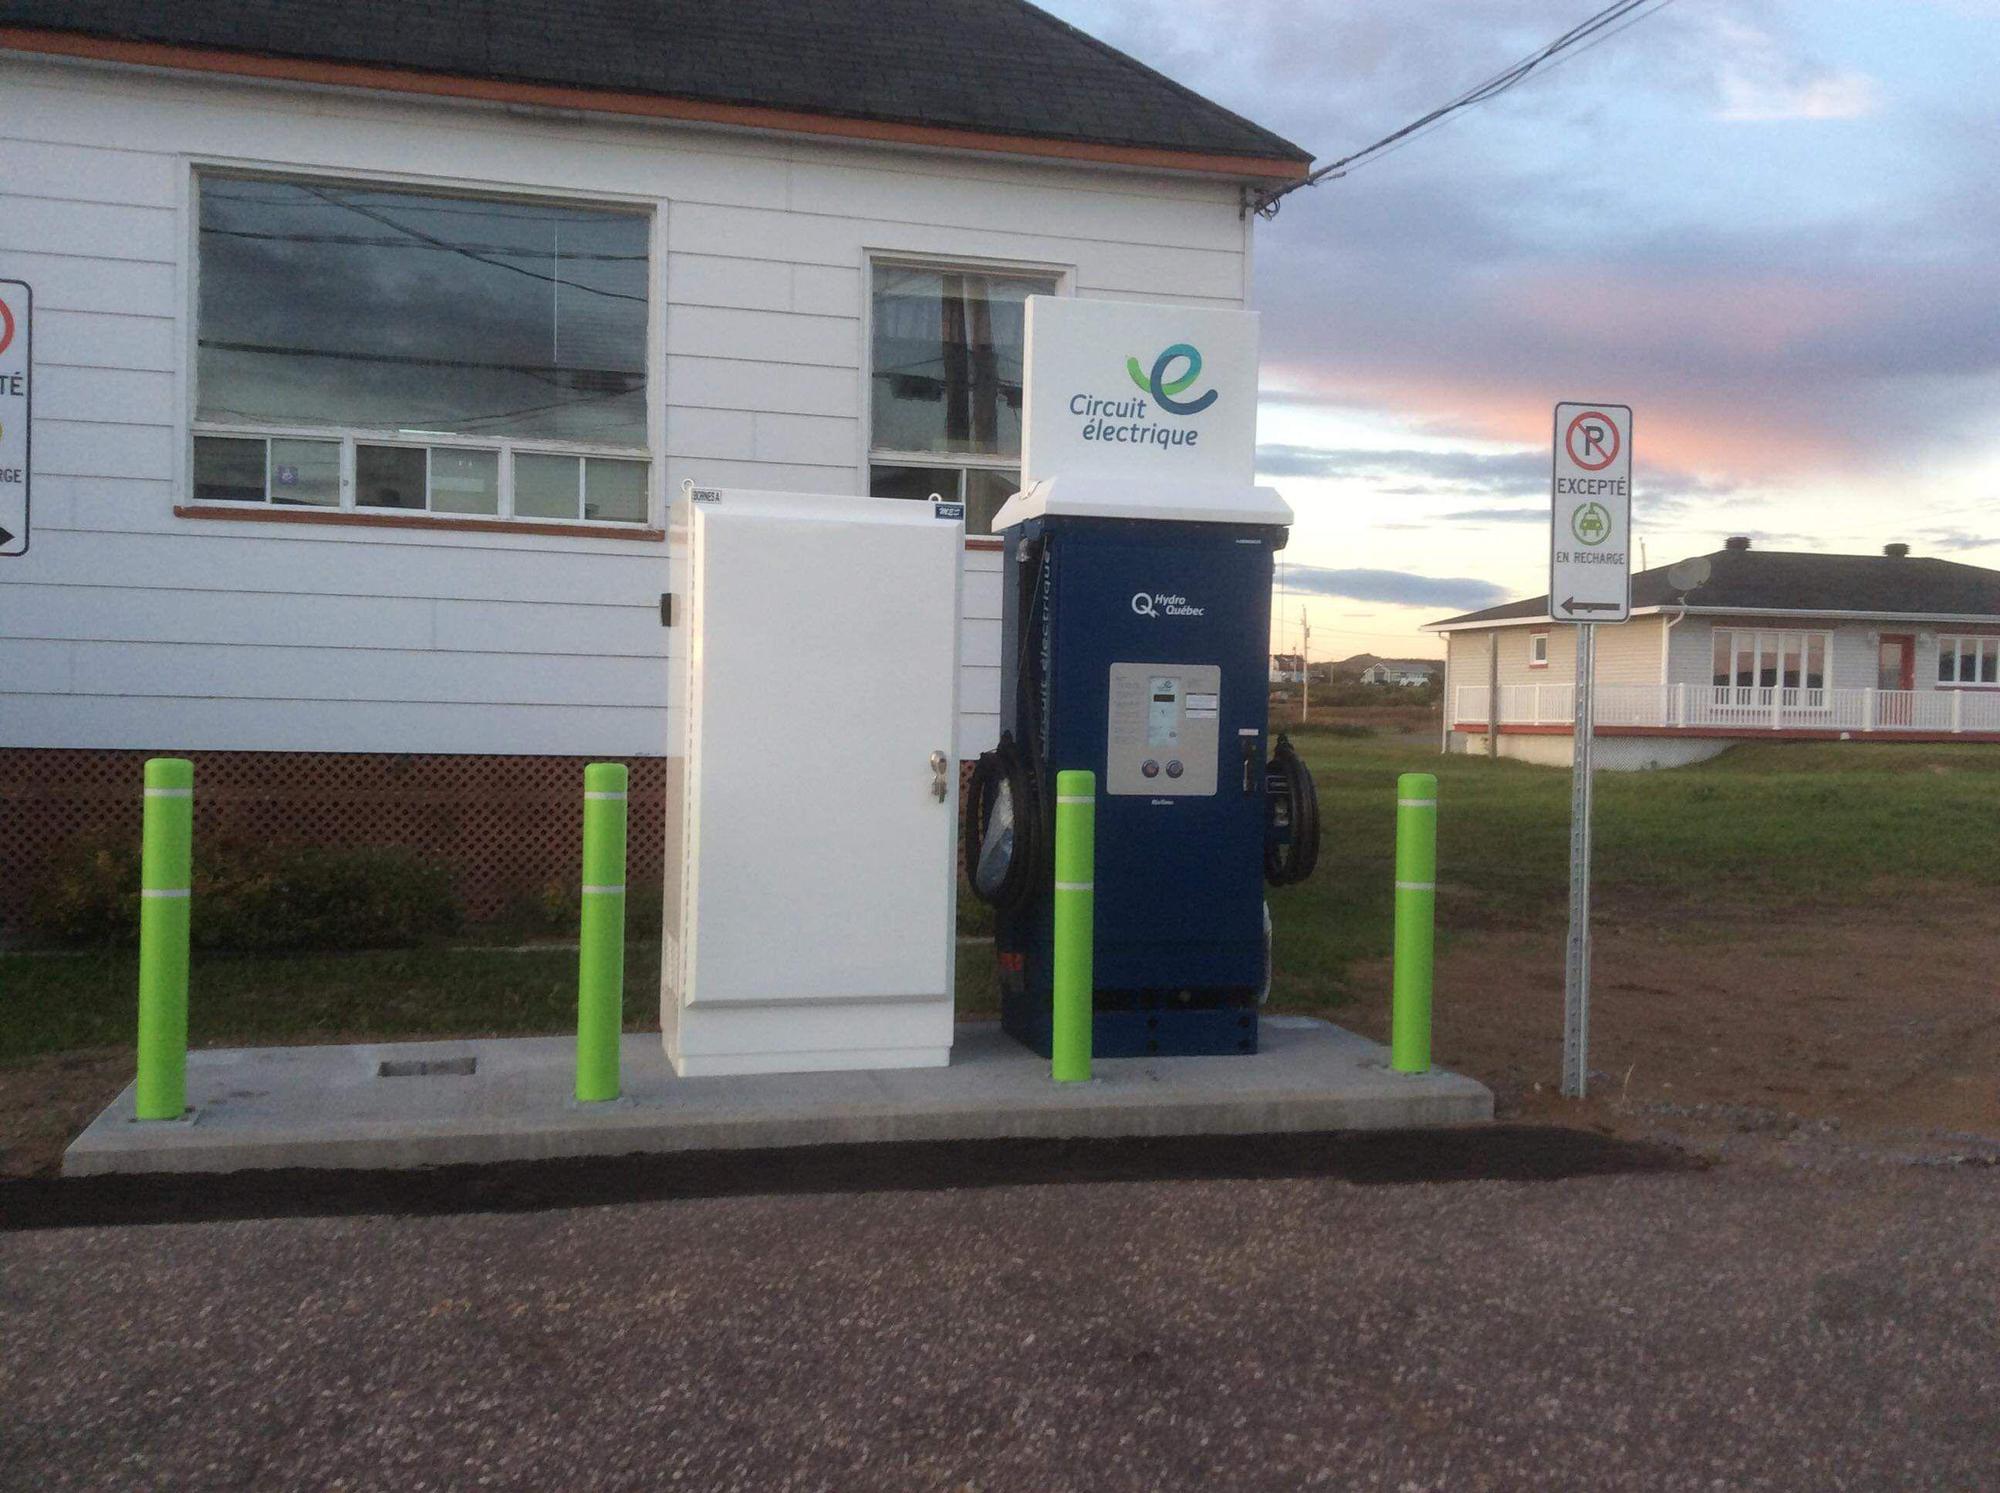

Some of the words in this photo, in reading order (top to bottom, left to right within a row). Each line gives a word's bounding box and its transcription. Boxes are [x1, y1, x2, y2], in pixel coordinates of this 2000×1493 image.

[1069, 394, 1148, 419] Circuit
[1082, 418, 1198, 450] électrique
[1557, 476, 1627, 496] EXCEPTÉ
[1556, 551, 1569, 563] EN
[1573, 552, 1625, 565] RECHARGE
[1154, 594, 1186, 606] Hydro
[1165, 605, 1205, 616] Québec
